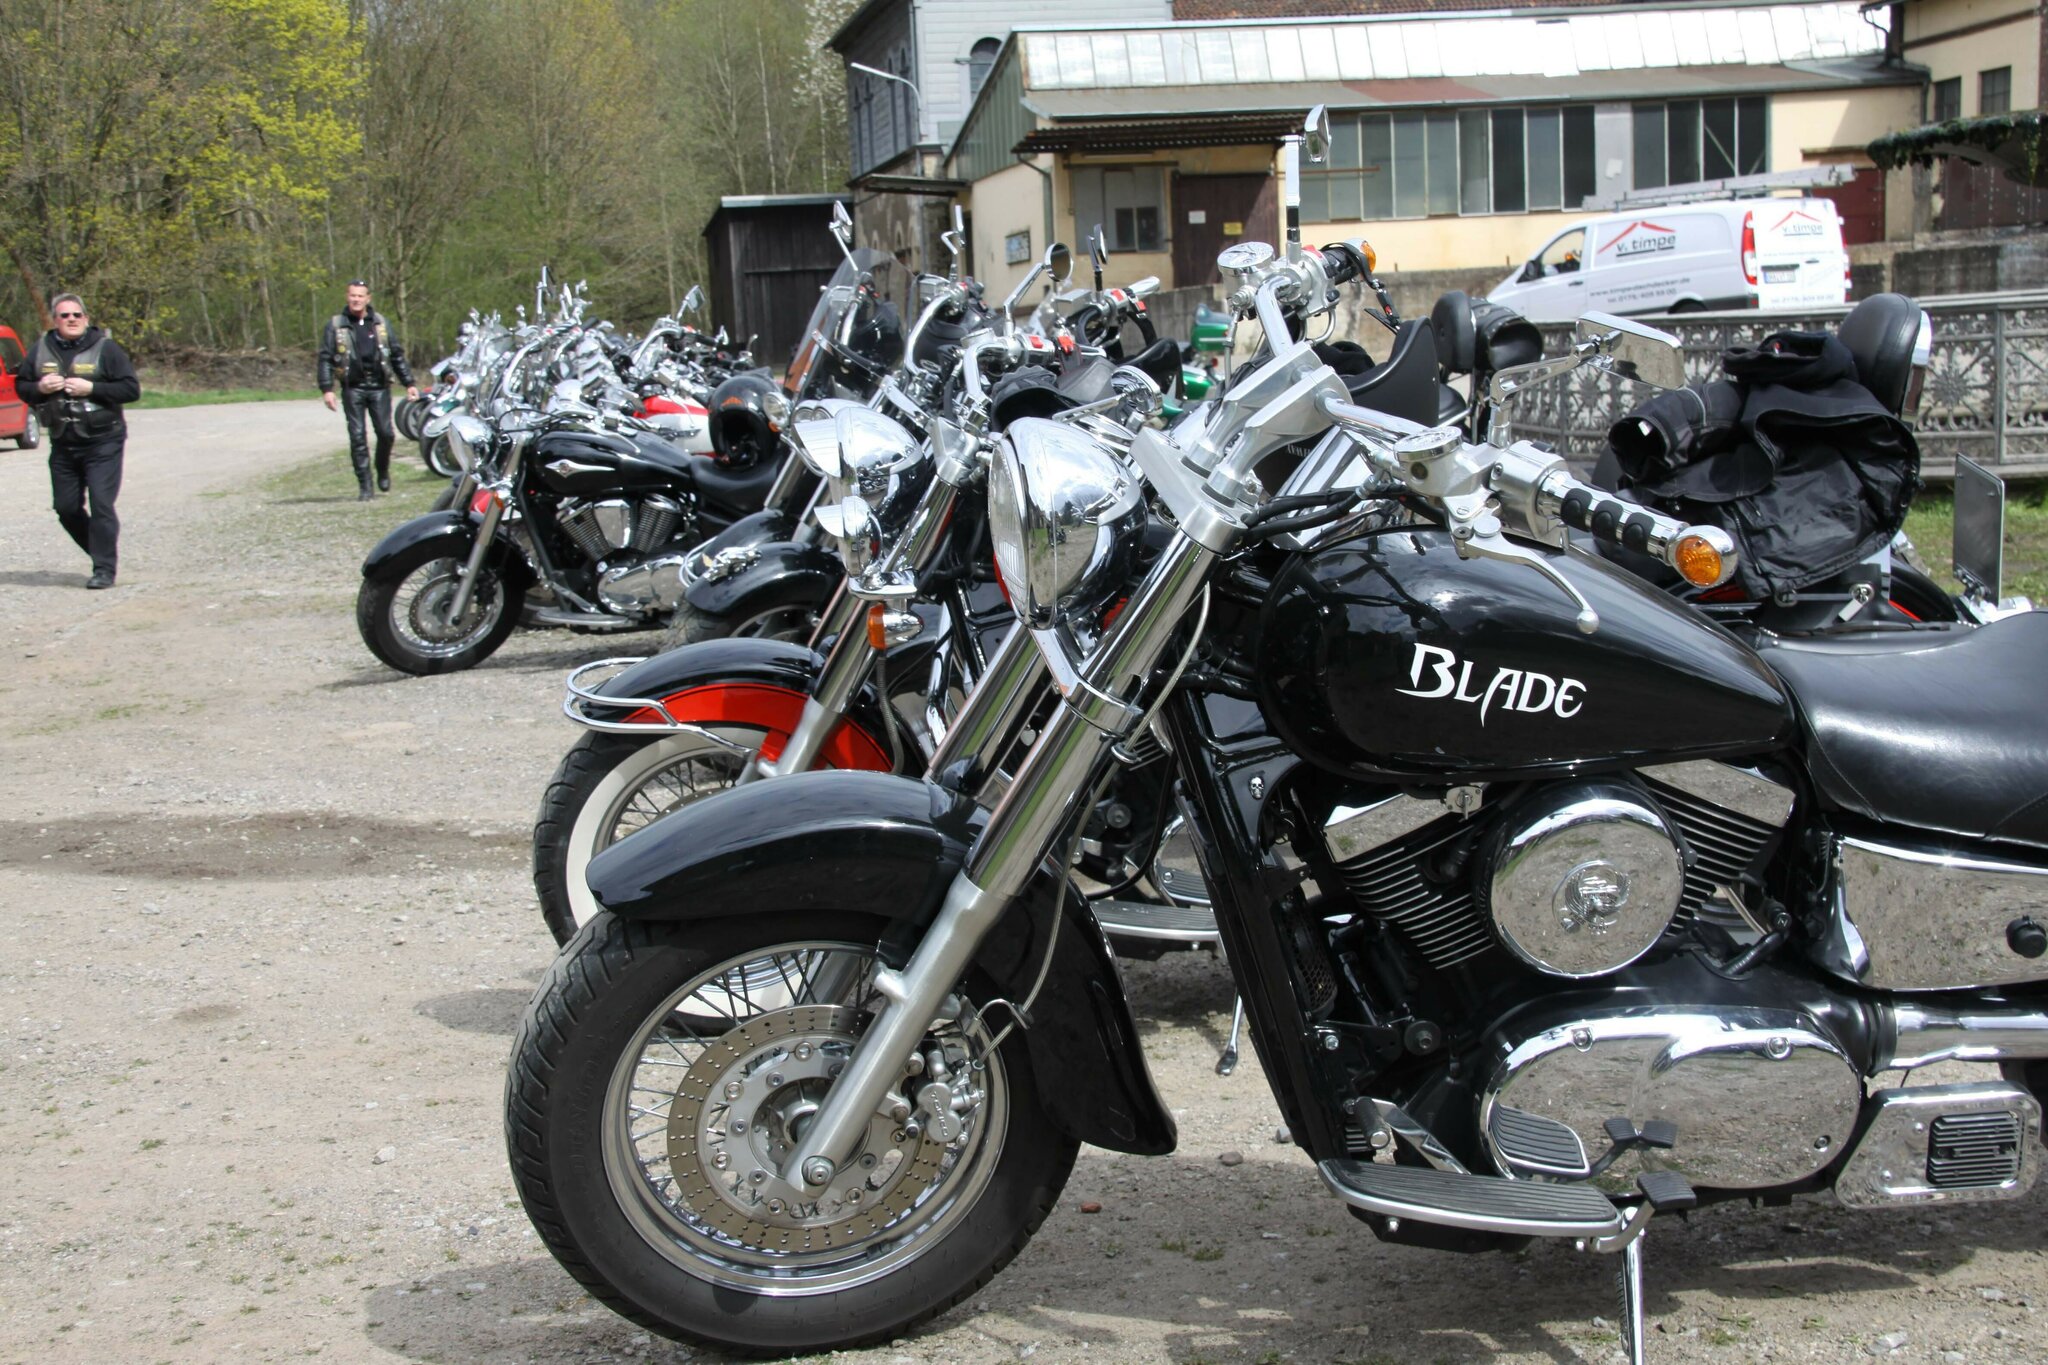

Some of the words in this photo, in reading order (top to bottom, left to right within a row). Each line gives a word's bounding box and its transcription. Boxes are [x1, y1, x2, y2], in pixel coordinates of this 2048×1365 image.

[1793, 224, 1823, 234] timpe
[1632, 235, 1676, 250] timpe
[1394, 642, 1587, 728] BLADE
